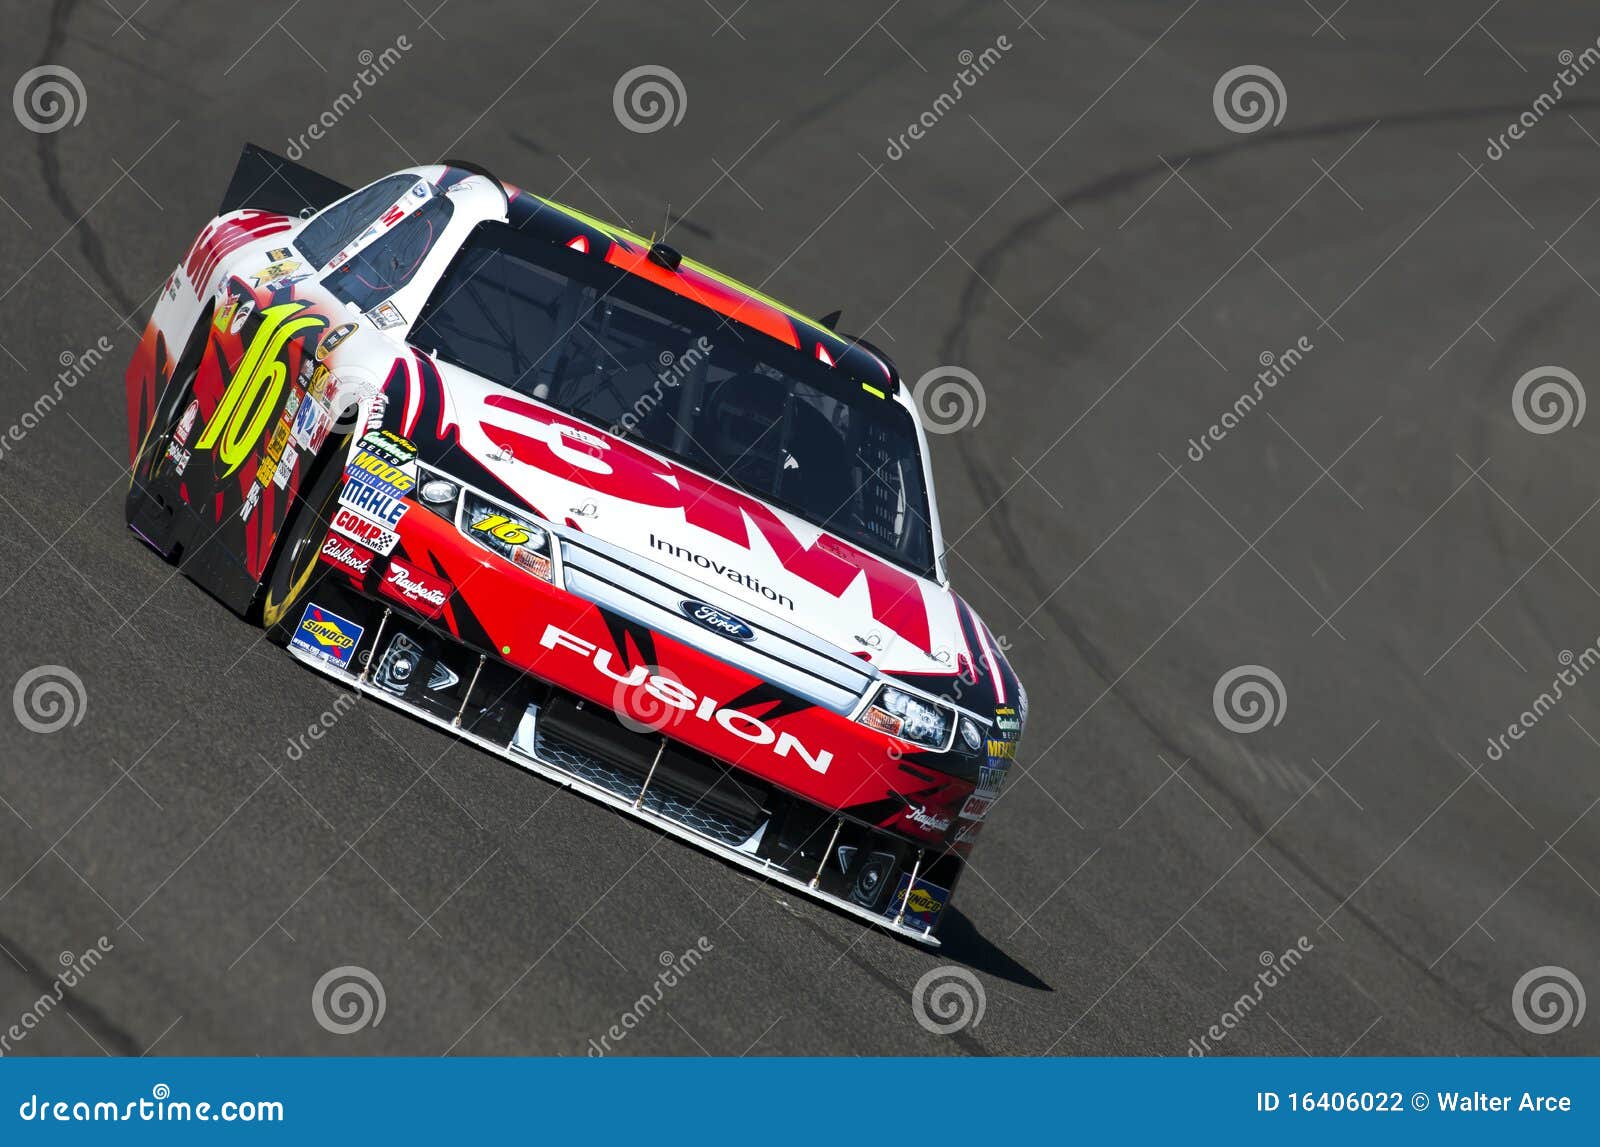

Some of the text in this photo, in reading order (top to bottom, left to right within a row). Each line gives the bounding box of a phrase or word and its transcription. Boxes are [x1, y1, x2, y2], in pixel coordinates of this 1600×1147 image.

[194, 302, 325, 480] 16
[351, 451, 416, 491] MOOG
[359, 441, 400, 465] BELTS
[340, 479, 408, 524] MAHLE
[335, 510, 383, 541] COMP
[471, 513, 536, 546] 16
[478, 394, 932, 656] 3M
[322, 538, 371, 574] Edelbrock
[360, 537, 385, 552] CAMS
[387, 561, 447, 606] Raybestos
[649, 533, 794, 611] Innovation
[304, 621, 353, 649] SUNOCO
[694, 605, 741, 635] Ford
[539, 623, 834, 775] FUSION
